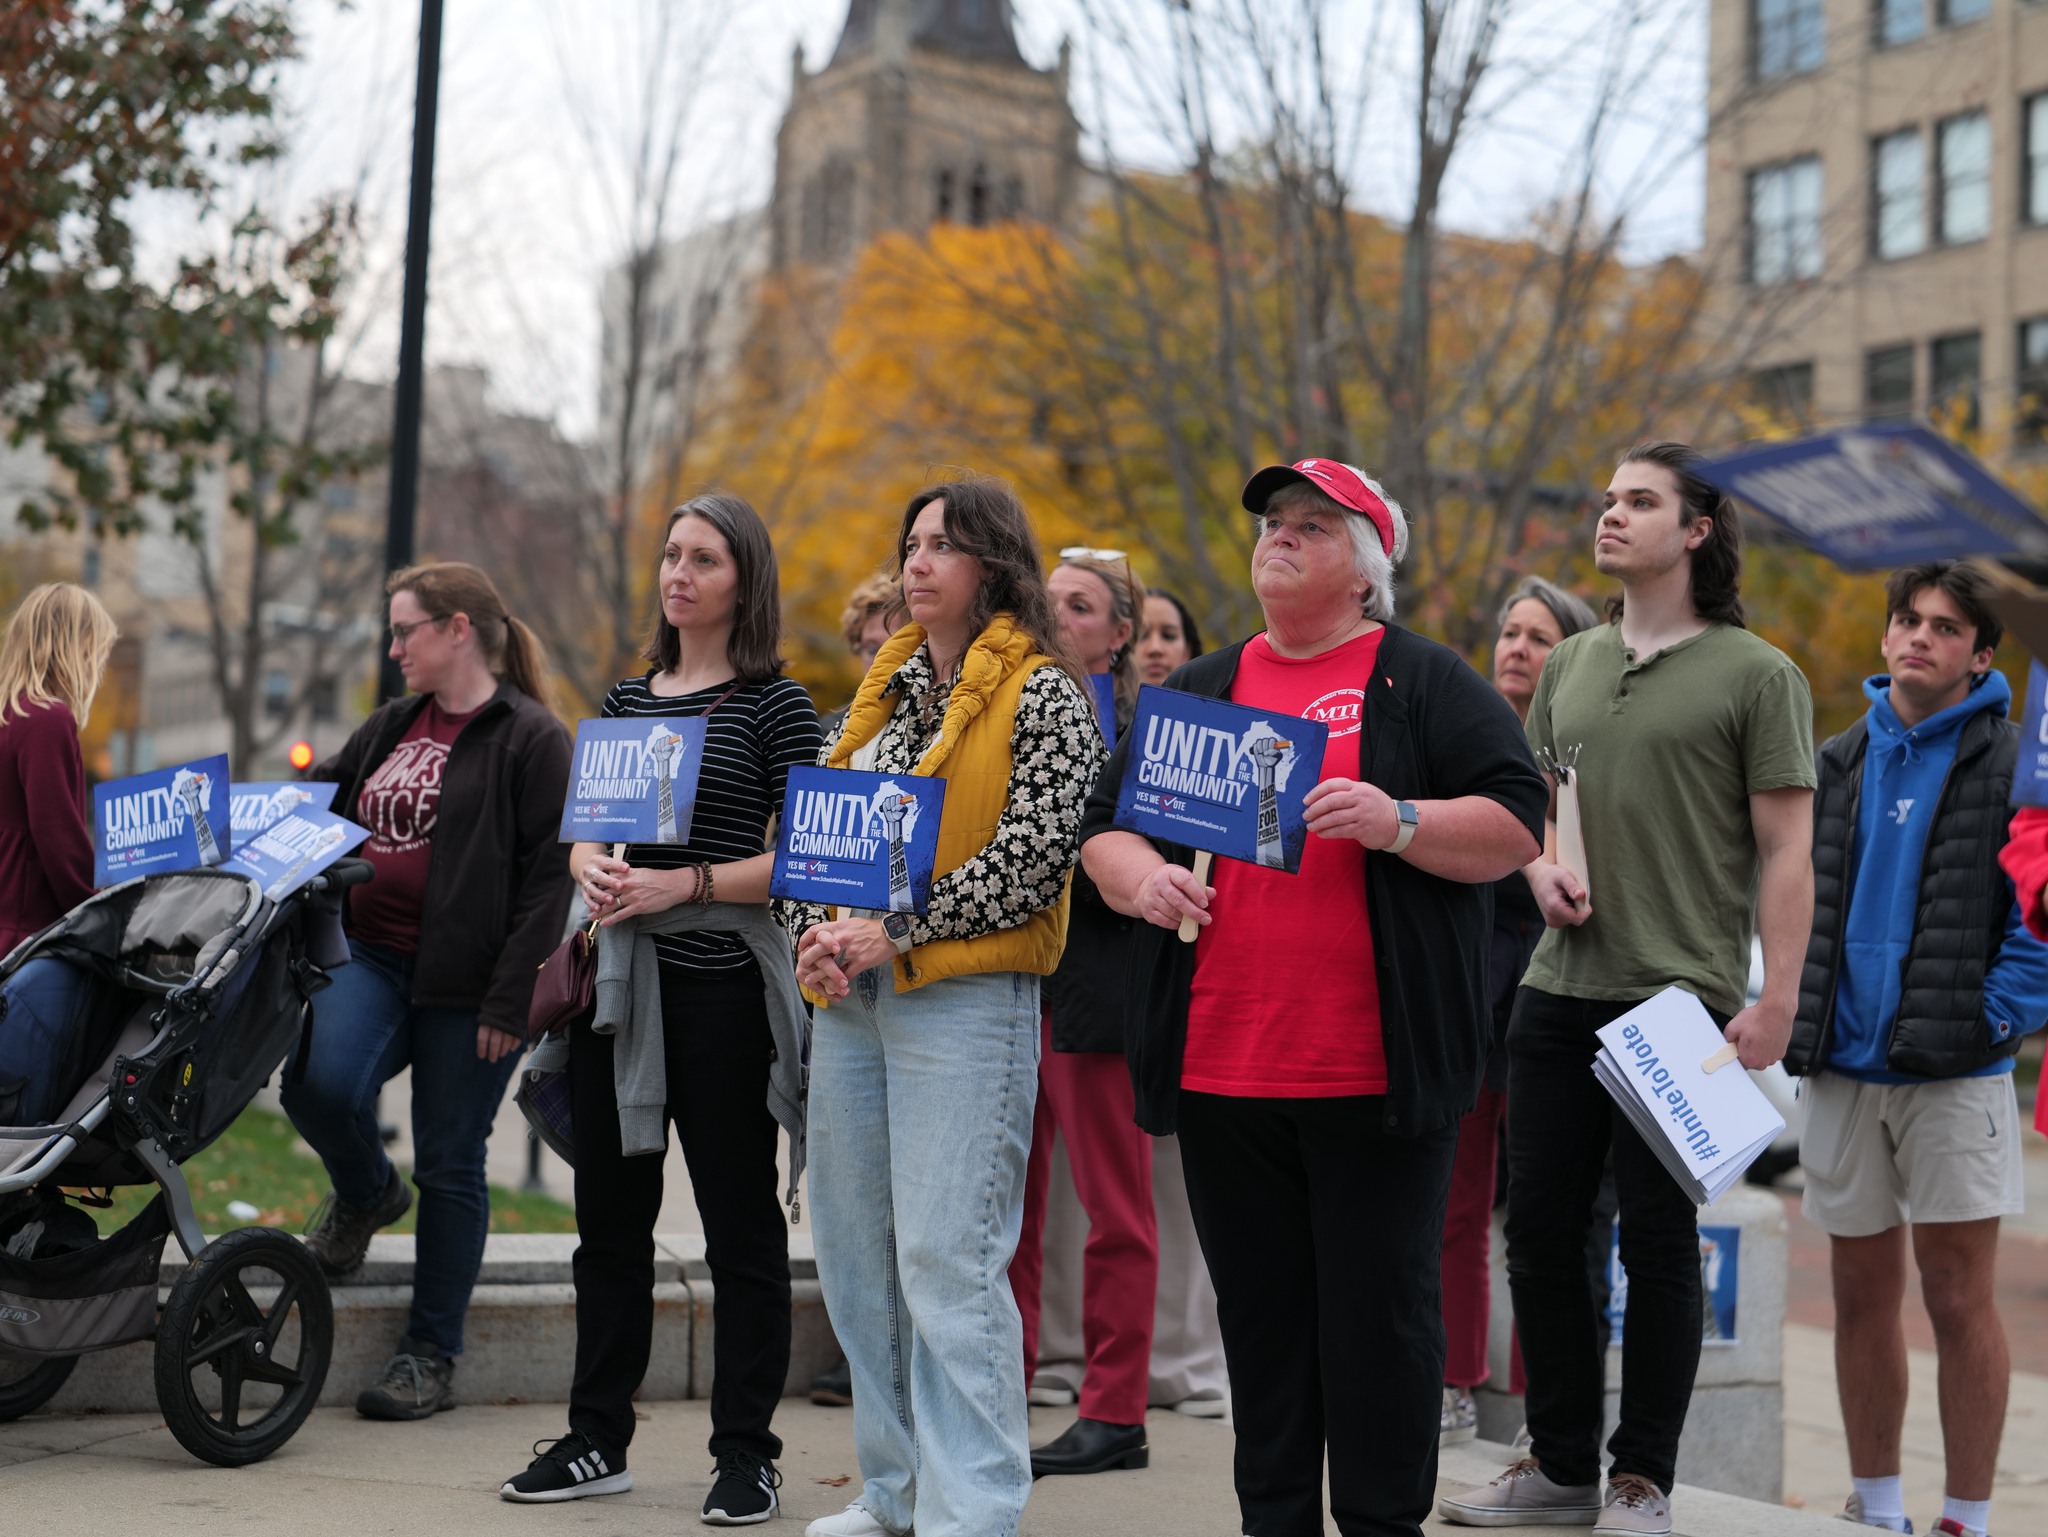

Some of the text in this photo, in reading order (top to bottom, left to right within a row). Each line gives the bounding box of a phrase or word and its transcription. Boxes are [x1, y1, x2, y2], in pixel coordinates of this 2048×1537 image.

[1313, 704, 1360, 720] MTI
[1144, 715, 1244, 780] UNITY
[580, 740, 648, 779] UNITY
[1240, 762, 1247, 772] IN
[644, 769, 652, 777] THE
[1238, 771, 1251, 782] THE
[576, 779, 651, 799] COMMUNITY
[1139, 760, 1248, 806] COMMUNITY
[659, 792, 672, 813] FOR
[1136, 791, 1149, 801] YES
[1150, 794, 1160, 805] WE
[1260, 784, 1275, 803] FAIR
[106, 786, 175, 832] UNITY
[575, 806, 583, 814] YES
[793, 790, 876, 838] UNITY
[1259, 808, 1277, 829] FOR
[266, 814, 321, 851] UNITY
[871, 829, 882, 838] THE
[872, 820, 878, 828] IN
[1259, 824, 1278, 840] PUBLIC
[106, 817, 184, 851] COMMUNITY
[789, 832, 880, 861] COMMUNITY
[891, 836, 903, 855] FAIR
[108, 854, 117, 862] YES
[788, 861, 797, 869] YES
[799, 862, 807, 870] WE
[891, 858, 906, 879] FOR
[1622, 1023, 1720, 1160] #UniteToVote
